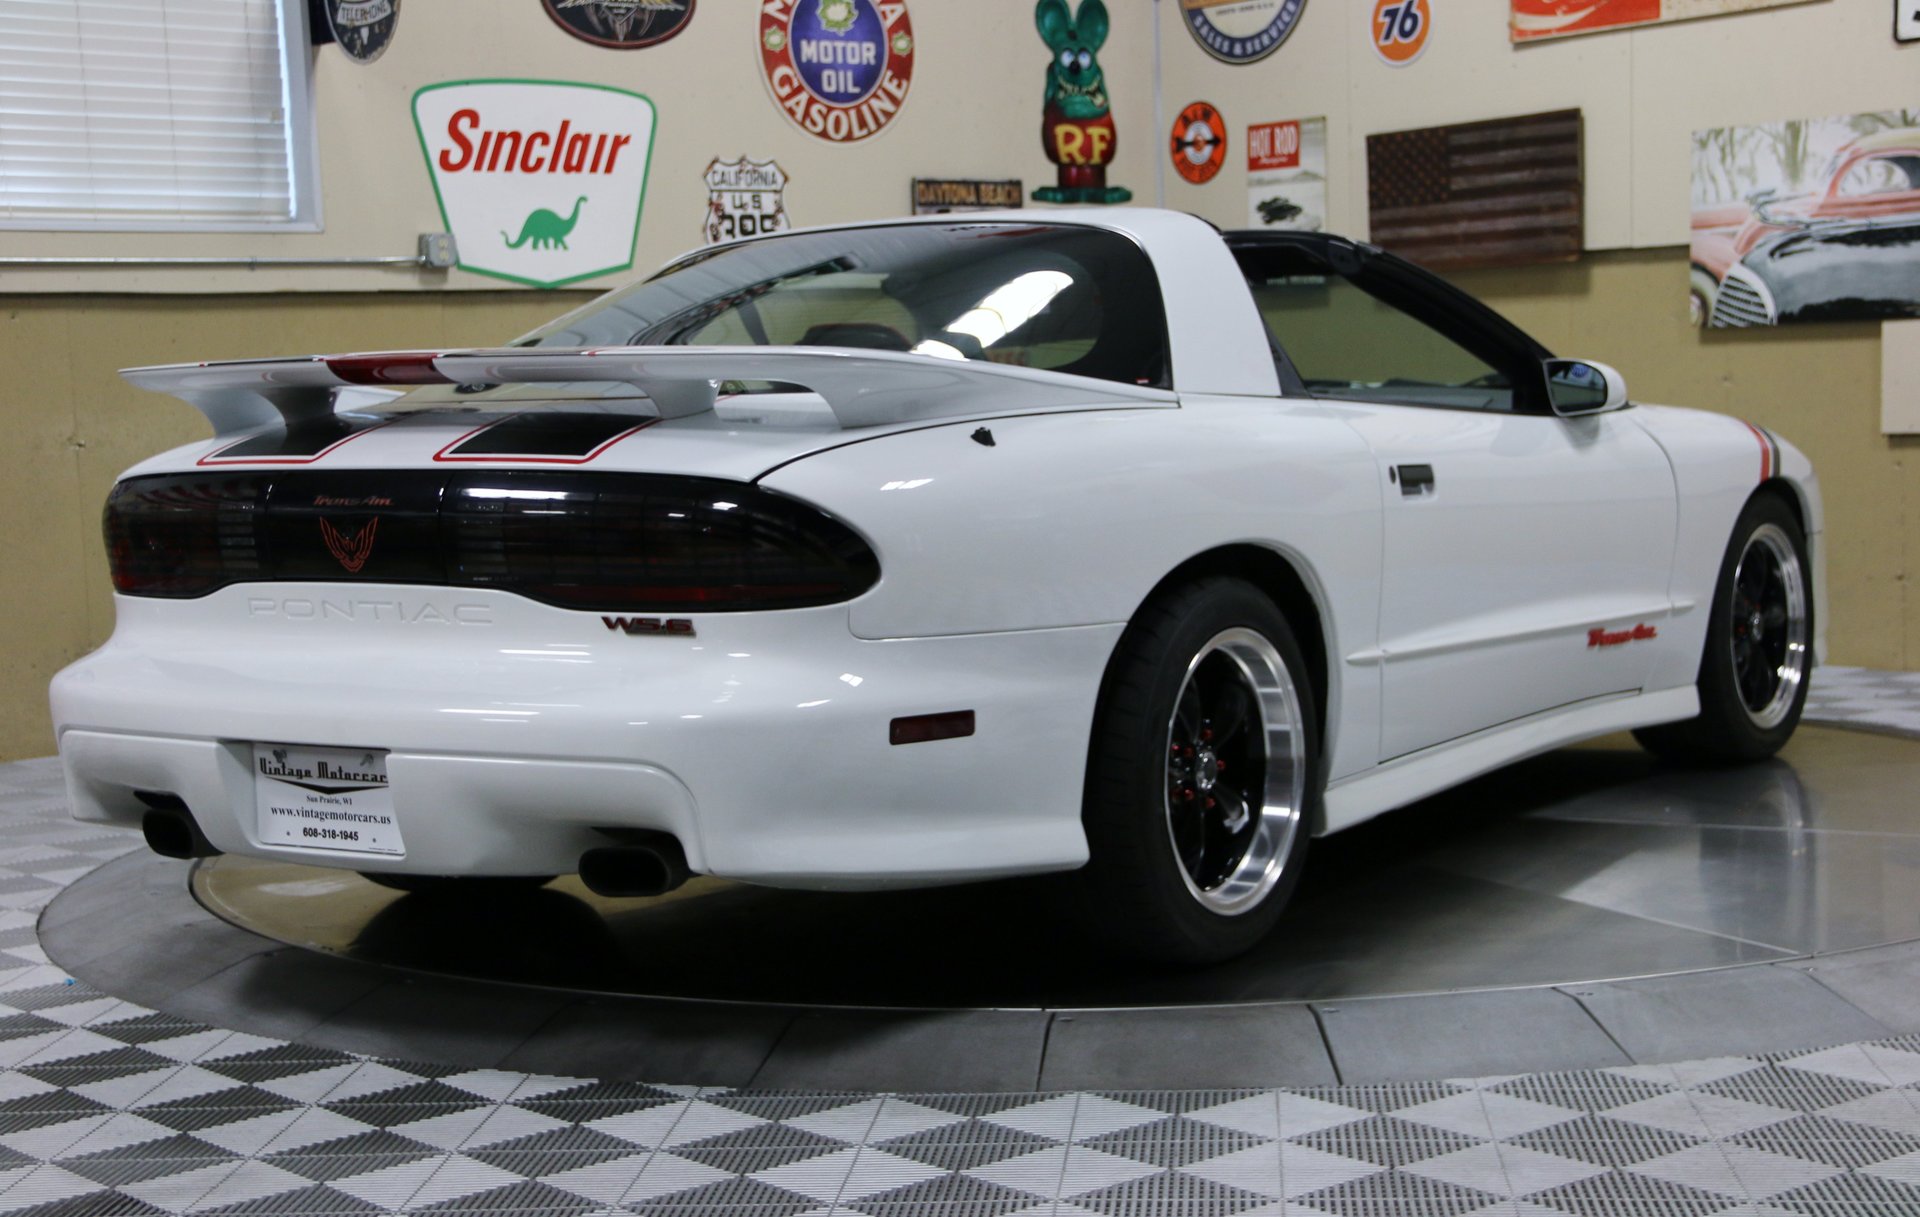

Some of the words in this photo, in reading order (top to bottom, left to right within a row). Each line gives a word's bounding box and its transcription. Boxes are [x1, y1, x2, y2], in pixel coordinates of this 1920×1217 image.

[1193, 15, 1231, 54] SALES
[1245, 1, 1297, 55] SERVICE
[1383, 0, 1418, 41] 76
[801, 39, 876, 65] MOTOR
[821, 69, 861, 93] OIL
[772, 65, 909, 140] GASOLINE
[439, 109, 631, 174] Sinclair
[1053, 123, 1111, 165] RF
[1249, 128, 1272, 159] HOT
[1274, 125, 1297, 155] ROD
[712, 169, 777, 187] CALIFORNIA
[247, 597, 493, 626] PONTIAC
[260, 757, 313, 780] Vintage
[306, 795, 319, 803] Sun
[271, 806, 392, 825] www.vintagemotorcars.us
[303, 827, 360, 842] 608-318-1945
